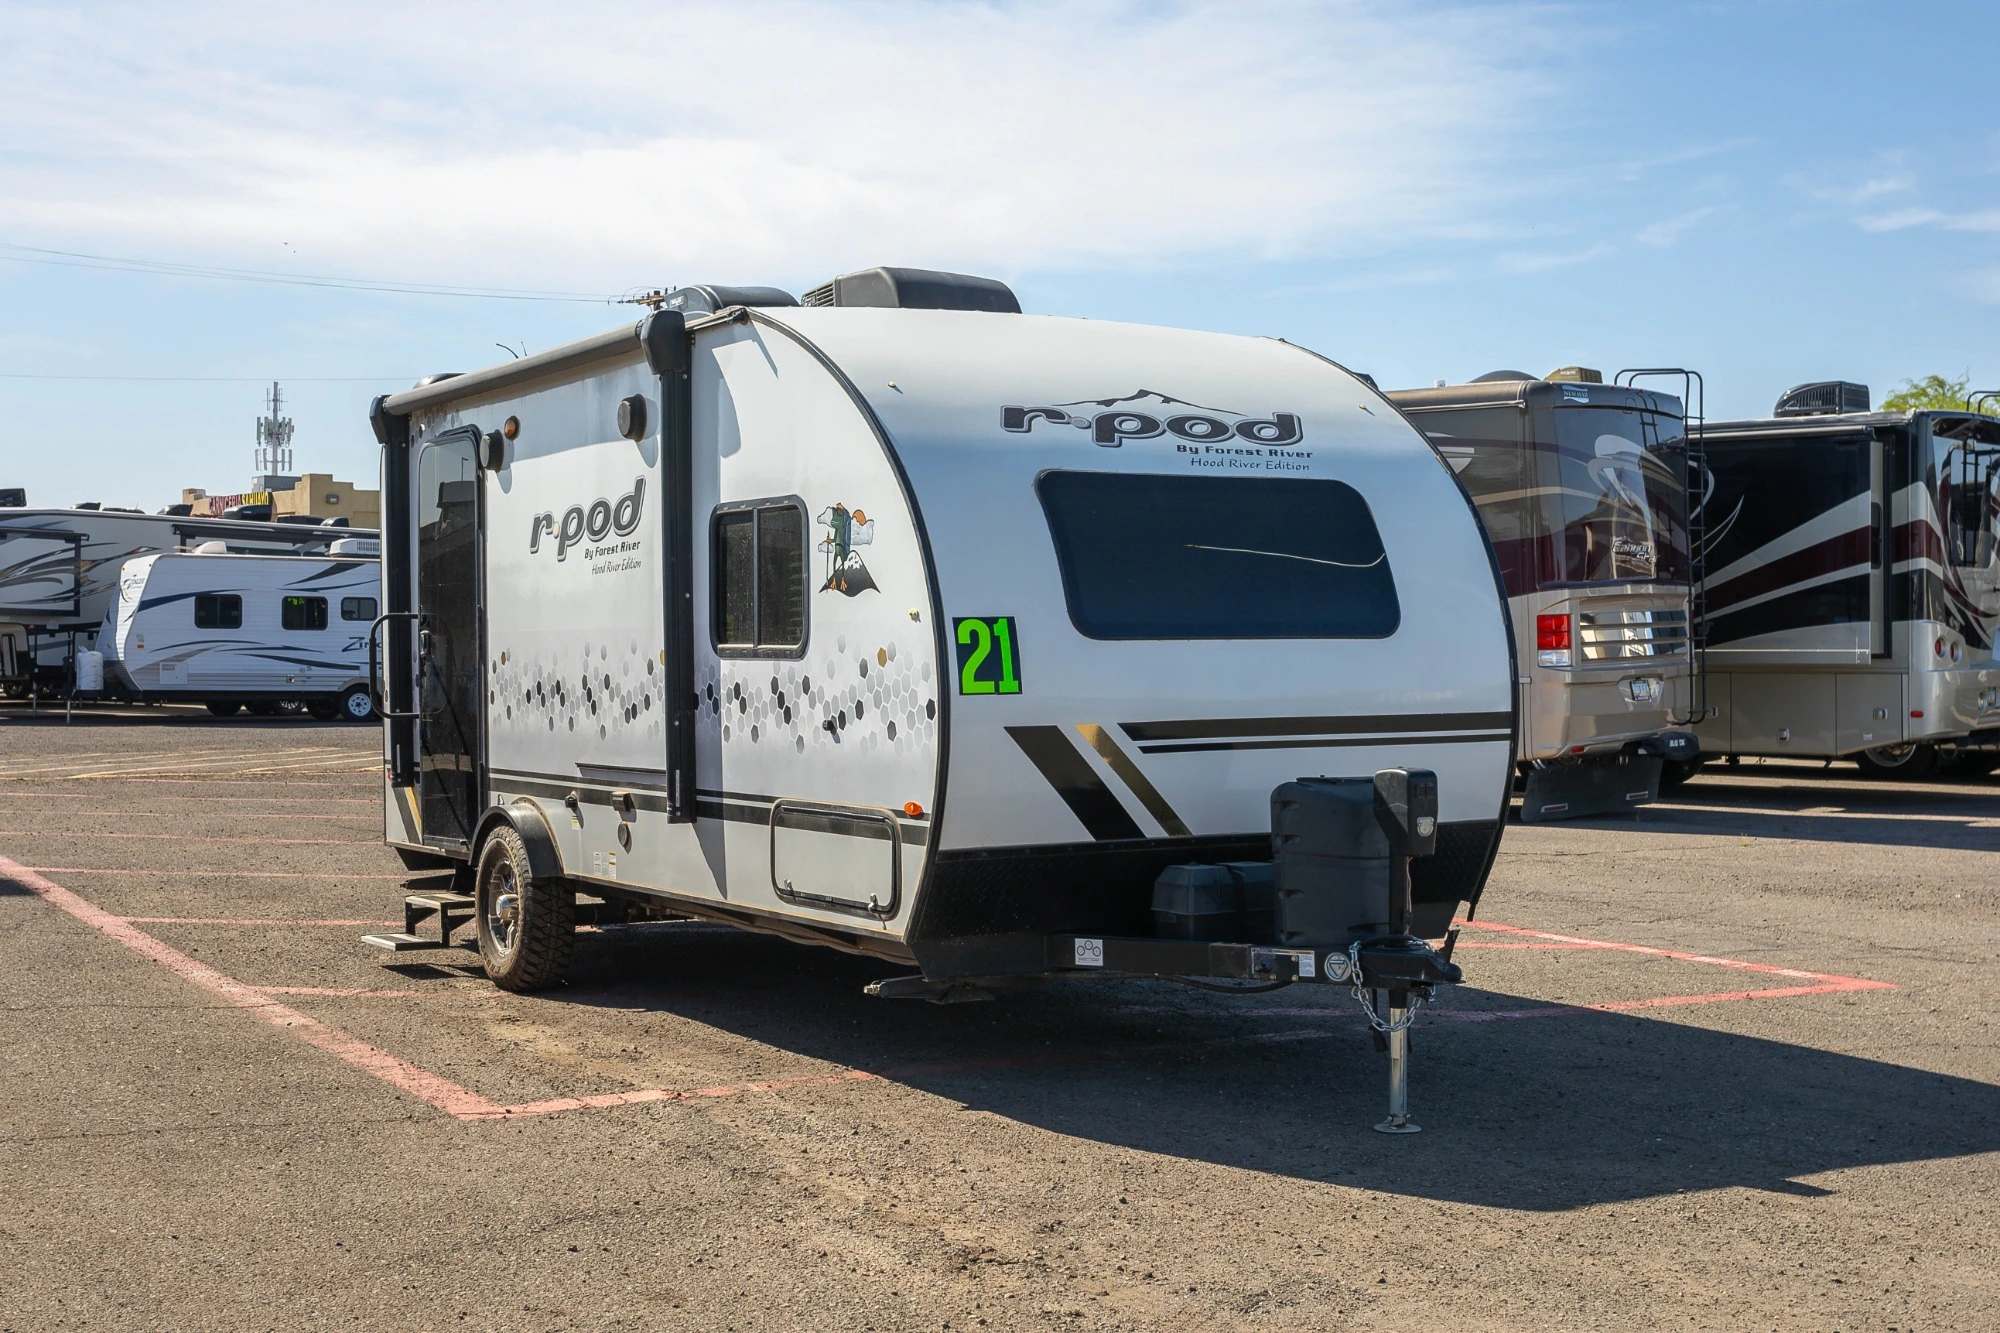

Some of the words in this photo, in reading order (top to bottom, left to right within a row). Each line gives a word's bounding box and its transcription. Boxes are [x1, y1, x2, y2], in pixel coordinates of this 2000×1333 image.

[1176, 444, 1199, 455] By
[1204, 445, 1263, 457] Forest
[1268, 448, 1313, 459] River
[1190, 457, 1224, 468] Hood
[1229, 458, 1262, 469] River
[1265, 460, 1310, 472] Edition
[584, 548, 594, 561] By
[594, 544, 619, 557] Forest
[620, 541, 641, 553] River
[957, 618, 1019, 693] 21
